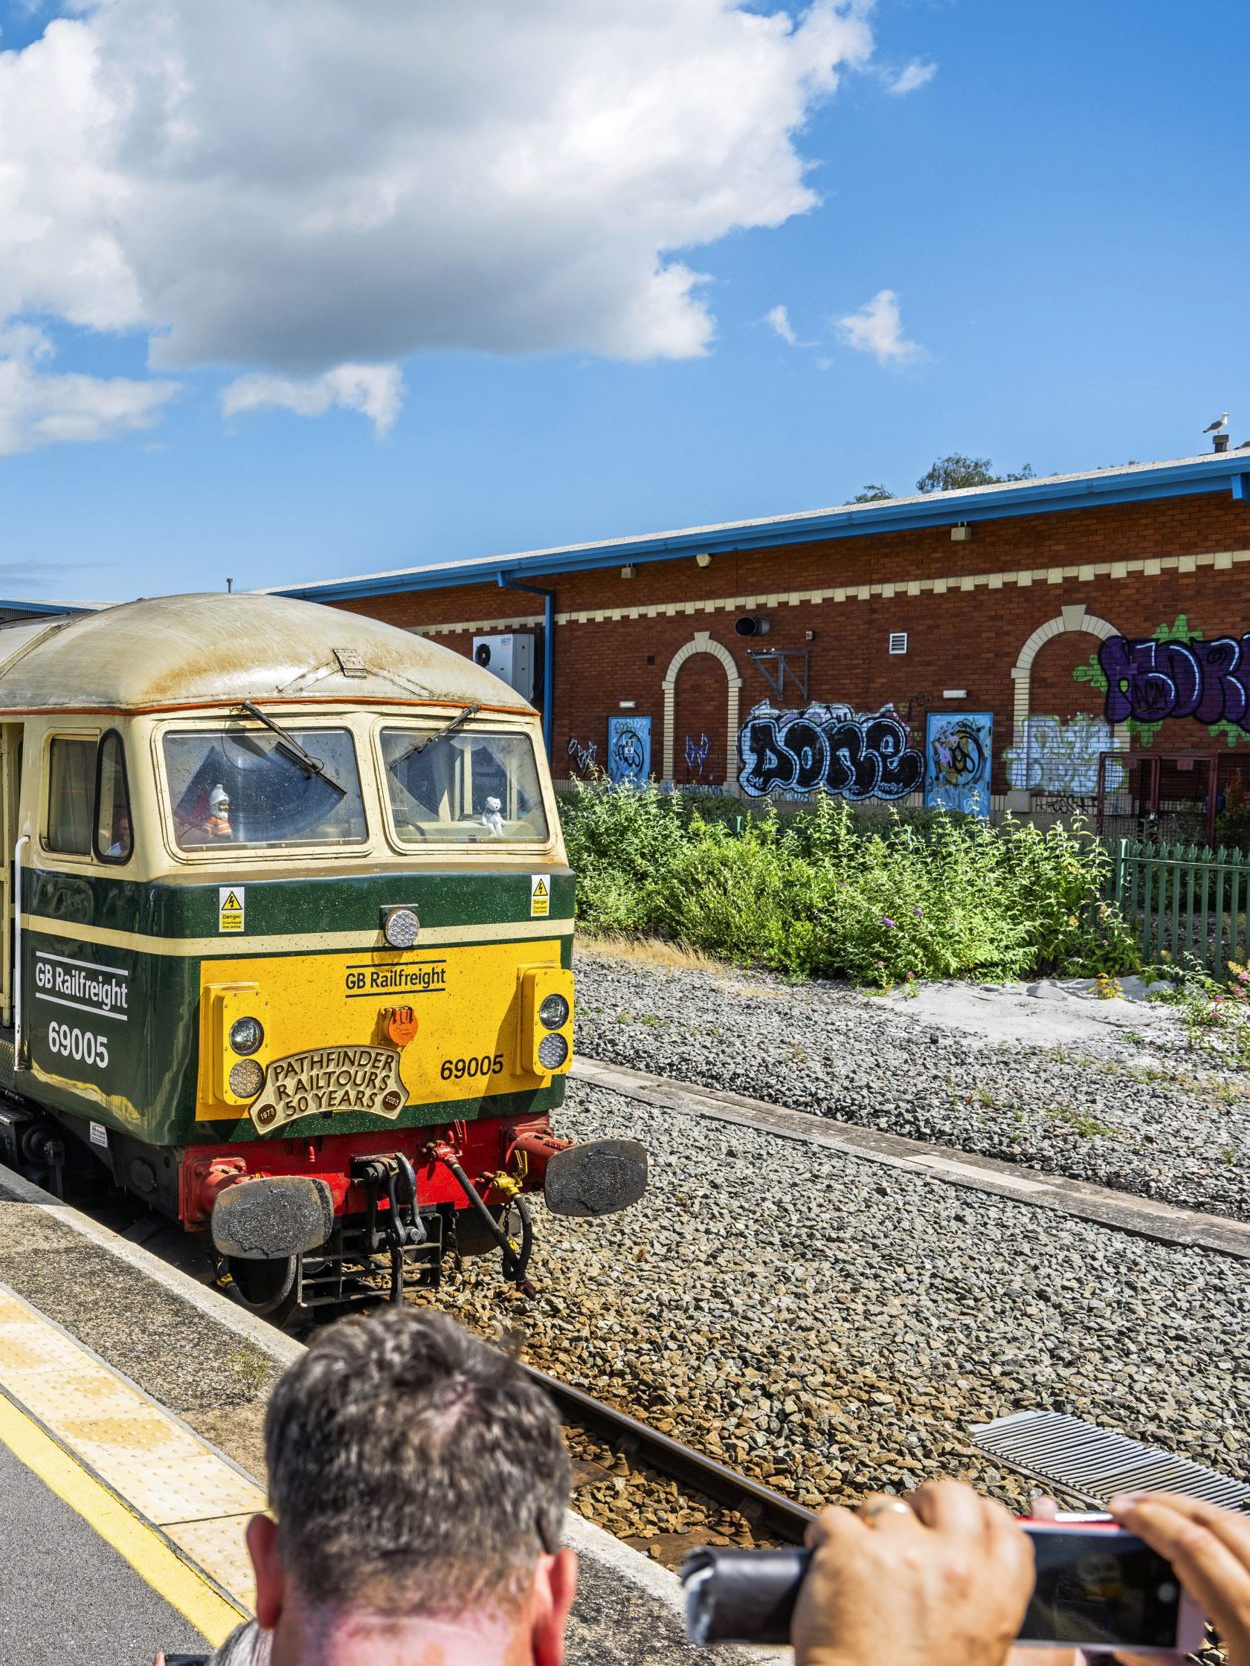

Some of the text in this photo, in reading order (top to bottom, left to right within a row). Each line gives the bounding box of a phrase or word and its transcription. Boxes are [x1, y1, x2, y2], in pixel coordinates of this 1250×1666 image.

[35, 962, 128, 1011] GB Railfreight
[345, 967, 446, 990] GB Railfreight
[48, 1021, 109, 1069] 69005
[273, 1050, 395, 1082] PATHFINDER
[440, 1054, 504, 1081] 69005
[276, 1069, 391, 1101] RAILTOURS
[259, 1107, 276, 1120] 1973
[285, 1089, 378, 1117] 50 YEARS
